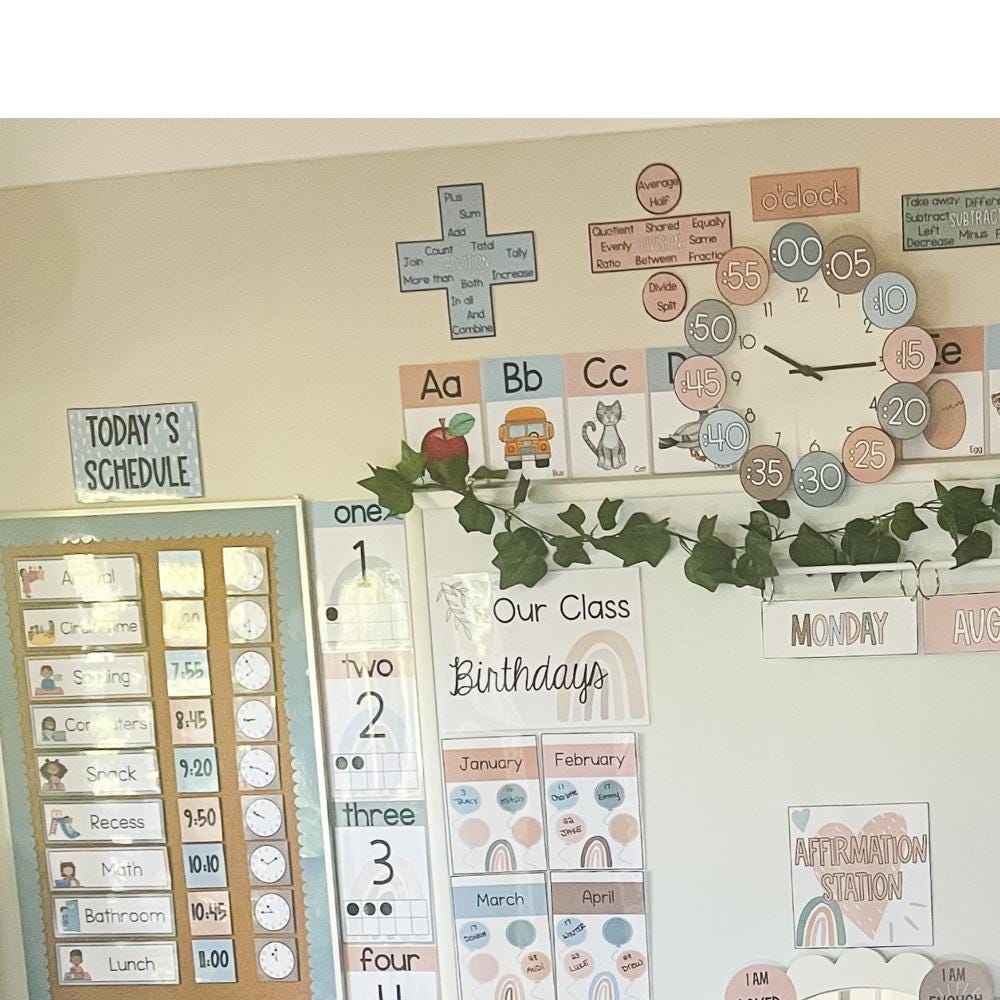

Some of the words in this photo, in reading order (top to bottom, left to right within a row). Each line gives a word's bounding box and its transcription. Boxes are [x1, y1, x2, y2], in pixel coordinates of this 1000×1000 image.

[638, 177, 679, 191] Average
[761, 182, 848, 211] o'clock
[906, 211, 949, 223] Subtract
[645, 221, 680, 233] Shared
[471, 241, 494, 251] Total
[601, 241, 631, 253] Evenly
[635, 254, 677, 265] Between
[649, 281, 677, 292] Divide
[453, 323, 493, 335] Combine
[504, 362, 542, 393] Bb
[584, 357, 628, 388] Cc
[421, 369, 462, 400] Aa
[86, 412, 179, 447] TODAY'S
[85, 456, 190, 489] SCHEDULE
[334, 504, 383, 523] one
[494, 598, 547, 623] Our
[561, 594, 630, 620] Class
[791, 612, 888, 647] MONDAY
[450, 656, 608, 703] Birthdays
[175, 710, 207, 729] 8:45
[180, 759, 212, 778] 9:20
[460, 757, 522, 771] January
[555, 753, 625, 768] February
[90, 815, 144, 830] Recess
[184, 808, 216, 826] 9:50
[343, 803, 415, 826] three
[795, 834, 927, 866] AFFIRMATION
[189, 855, 219, 872] 10:10
[821, 872, 902, 901] STATION
[477, 893, 524, 907] March
[582, 890, 614, 904] April
[85, 908, 165, 923] Bathroom
[192, 903, 226, 921] 10:45
[109, 957, 155, 972] Lunch
[360, 948, 420, 972] four
